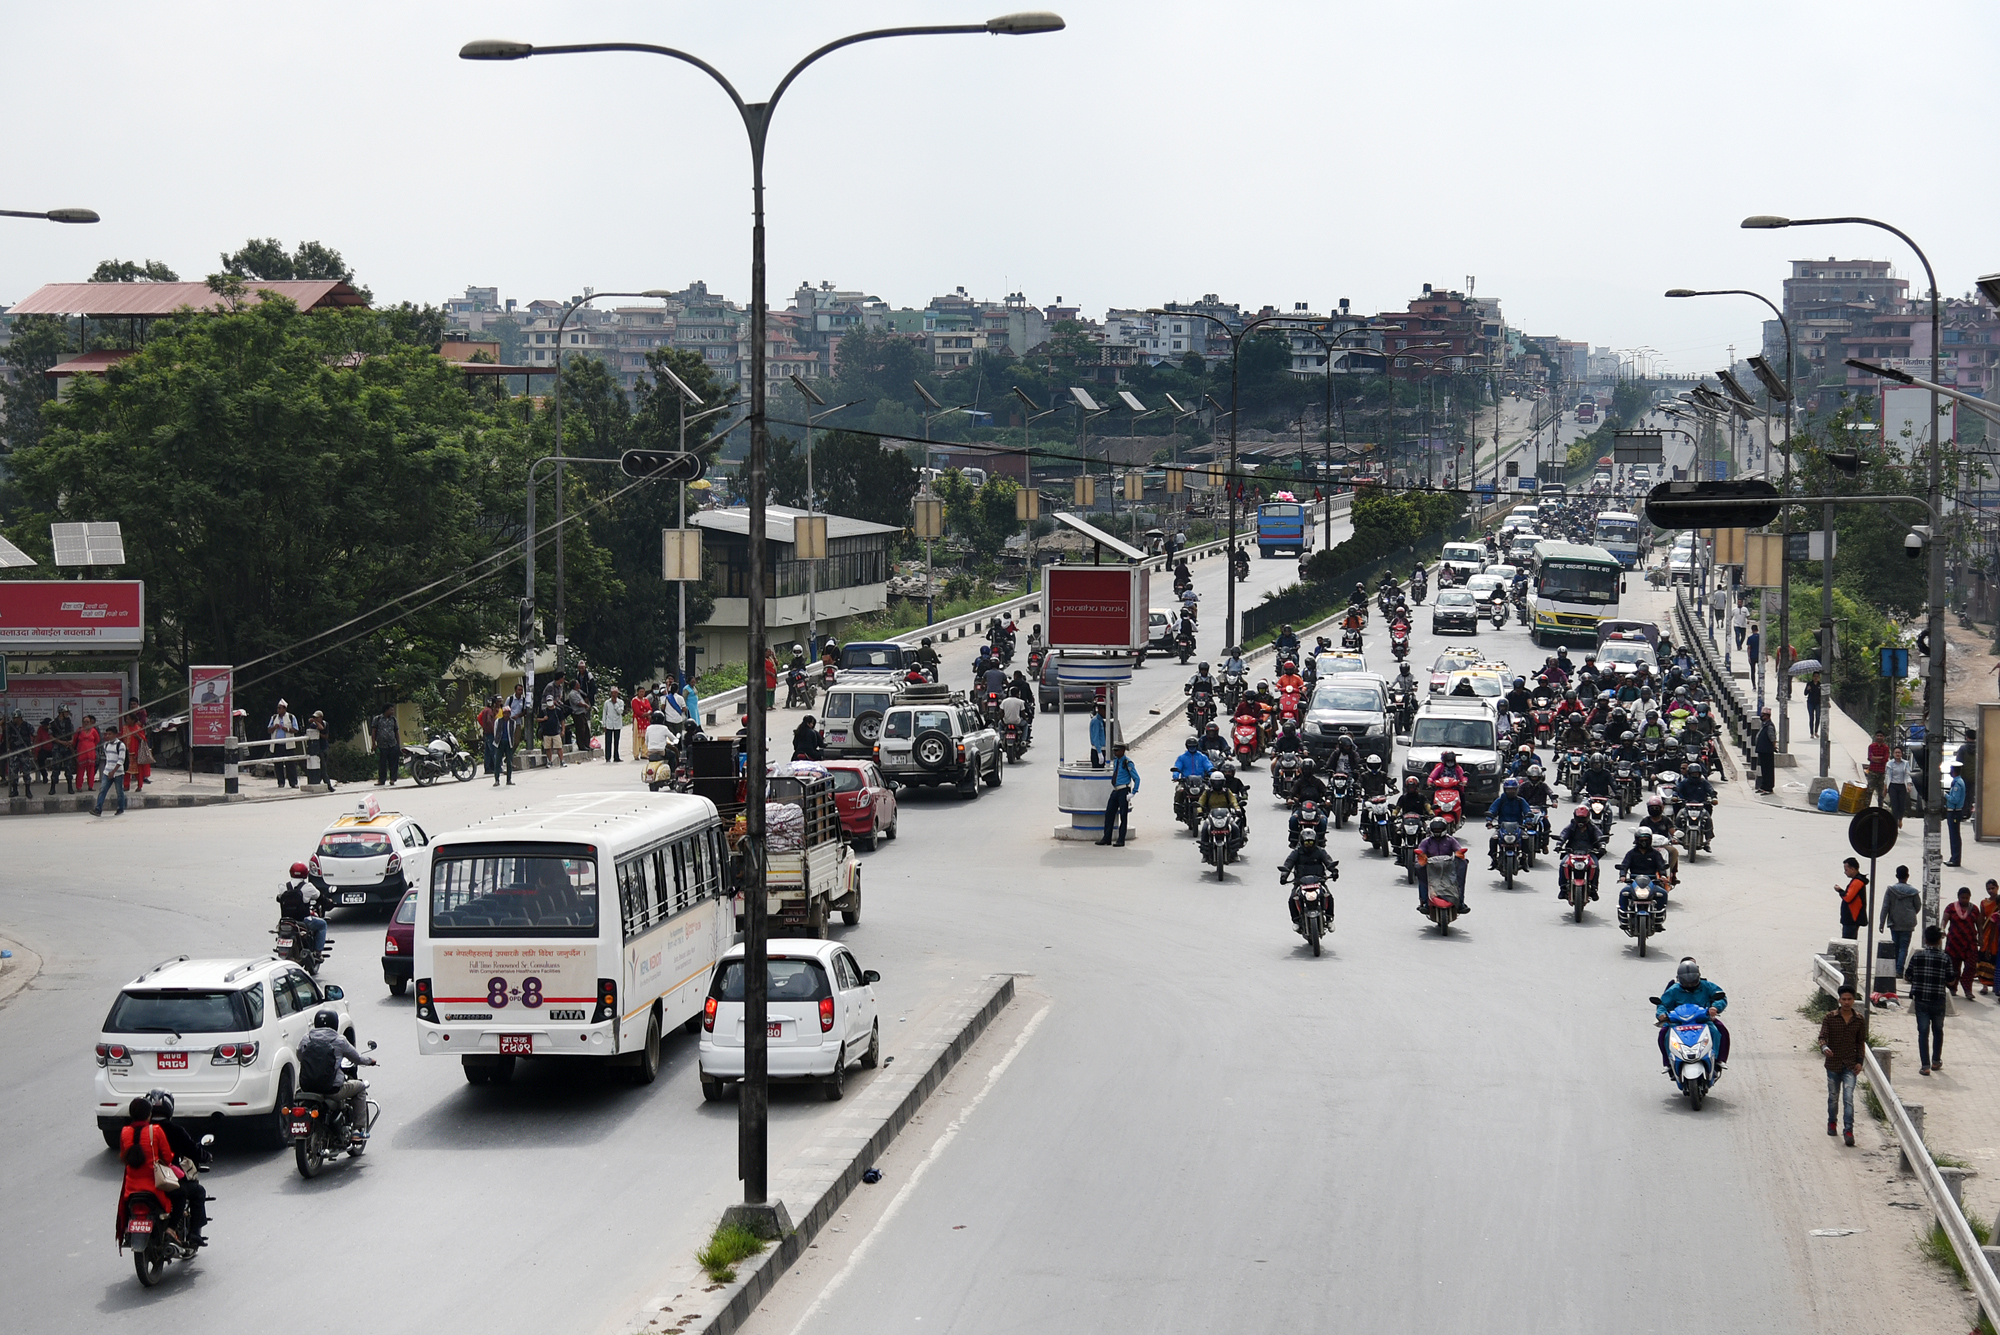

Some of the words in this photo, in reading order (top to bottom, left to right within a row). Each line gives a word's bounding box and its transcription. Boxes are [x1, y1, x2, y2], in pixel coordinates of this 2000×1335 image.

[487, 976, 509, 1009] 8
[521, 976, 544, 1009] 8
[551, 1011, 584, 1019] TATA
